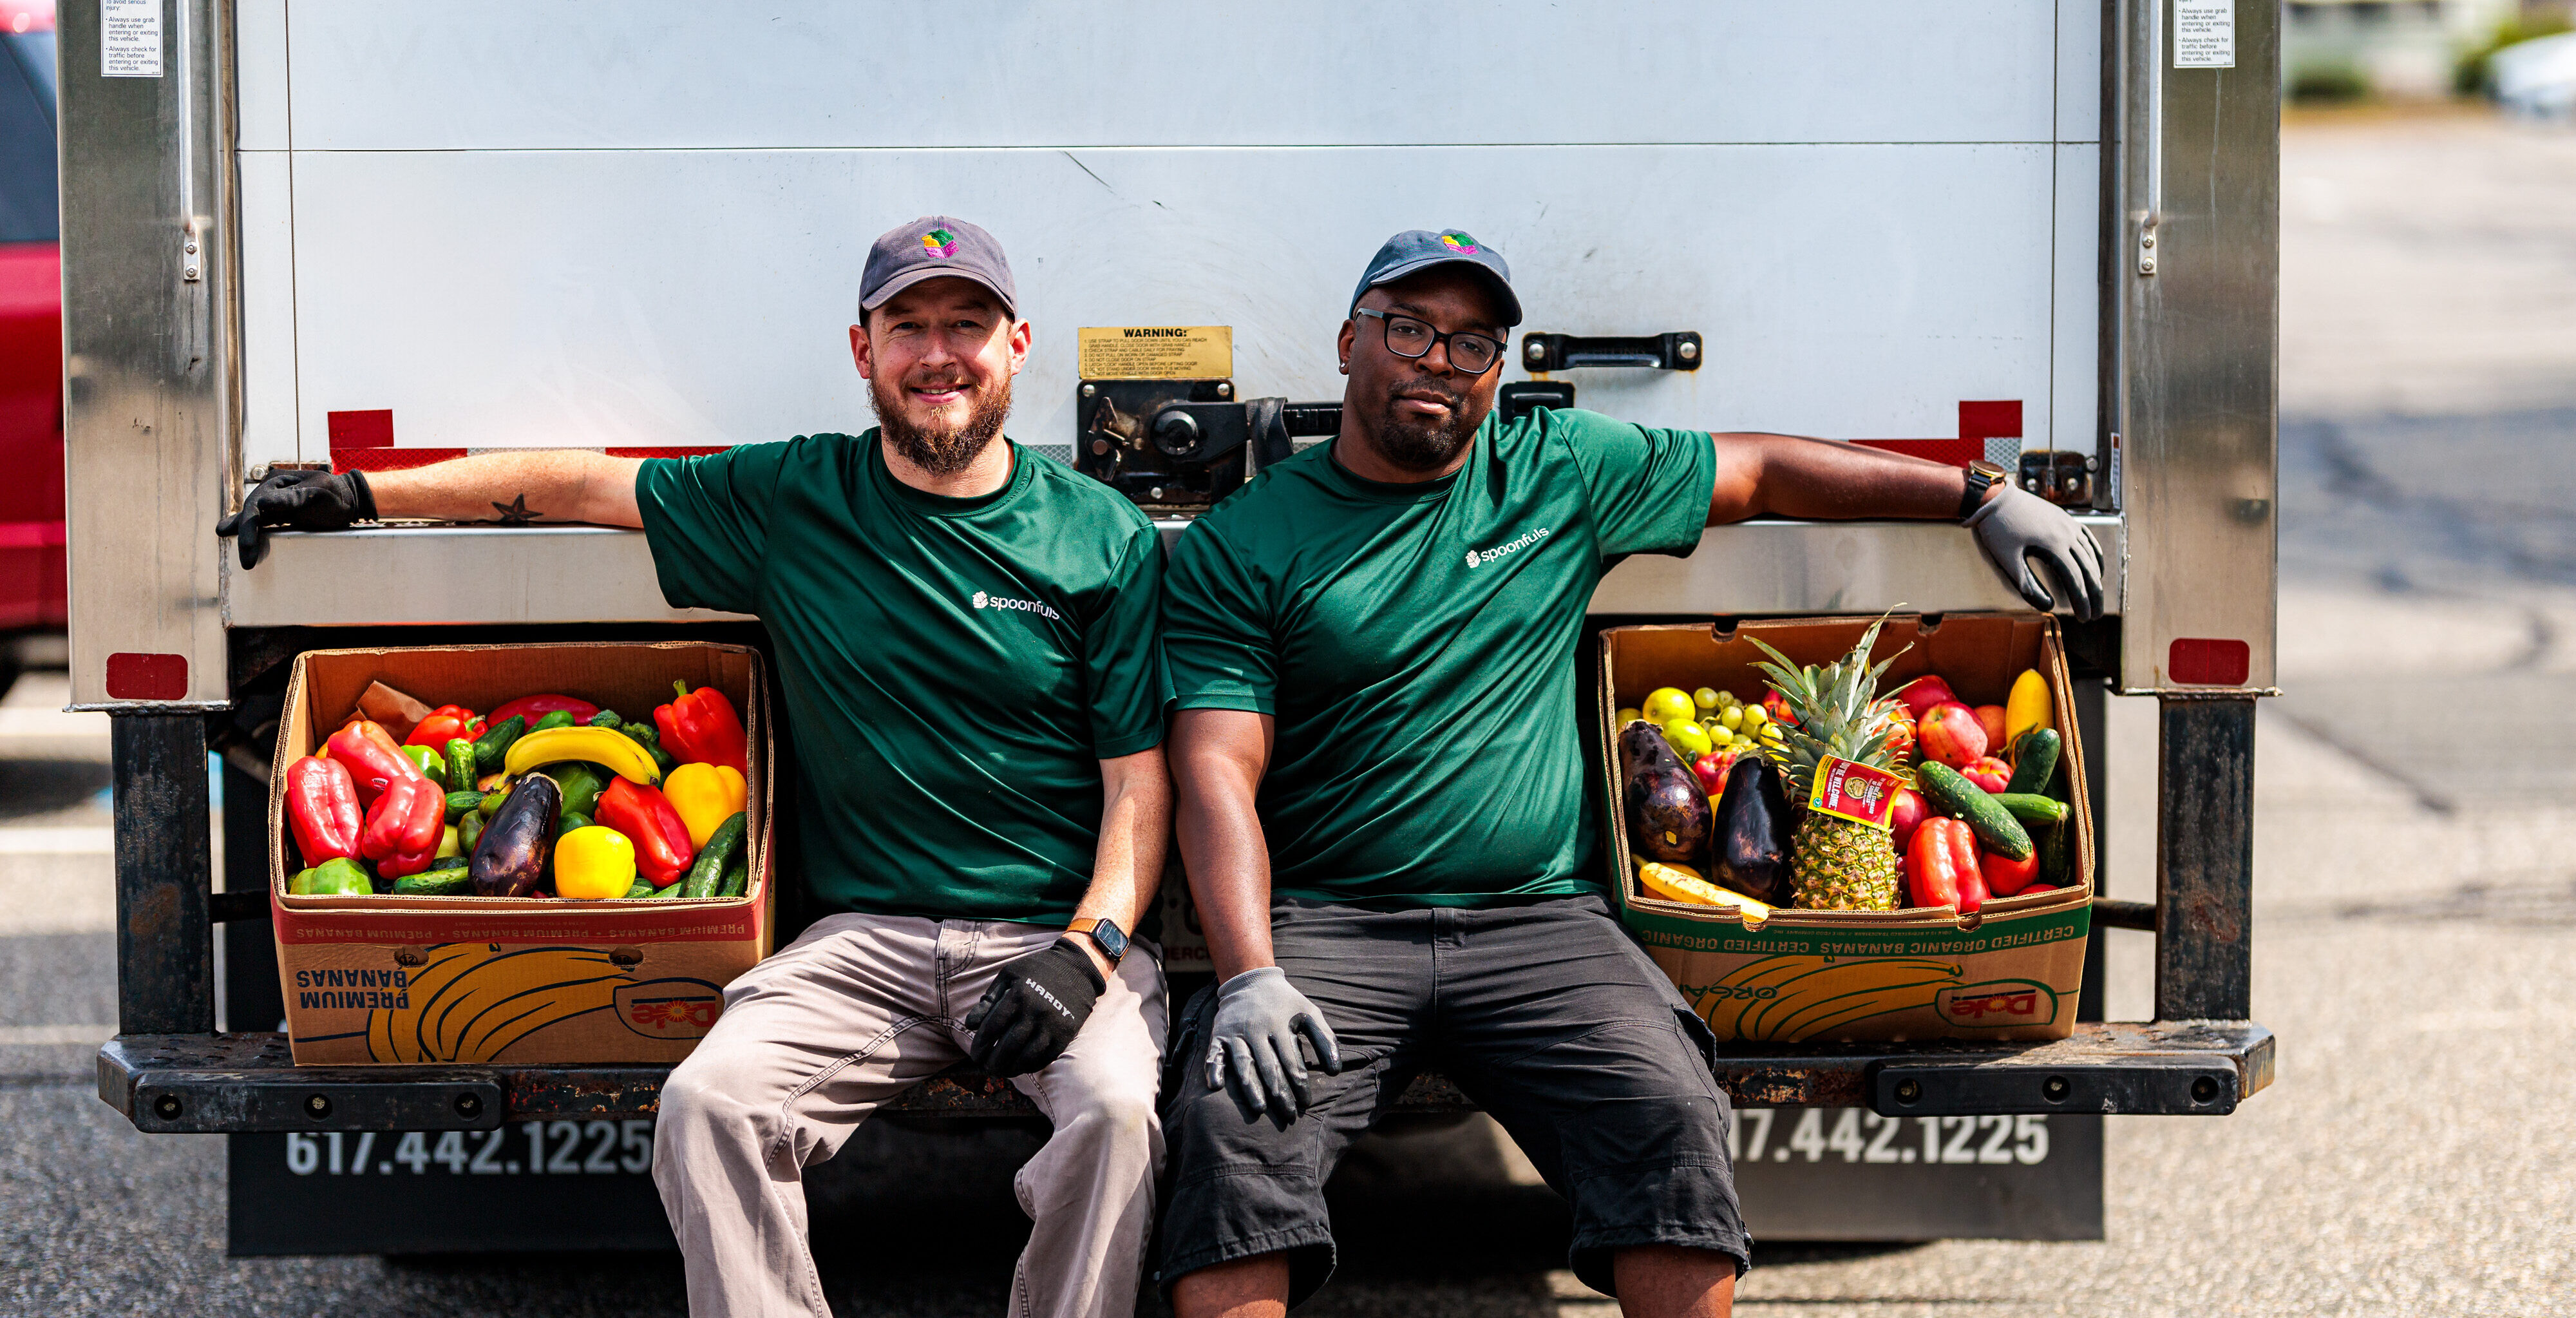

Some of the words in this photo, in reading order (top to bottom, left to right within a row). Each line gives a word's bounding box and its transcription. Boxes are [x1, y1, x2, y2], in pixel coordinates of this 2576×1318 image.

[1124, 328, 1187, 338] WARNING:
[1481, 528, 1549, 562] spoonfuls
[990, 597, 1060, 620] spoonfuls
[296, 928, 363, 938] BANANAS
[366, 930, 432, 939] PREMIUM
[452, 930, 520, 938] BANANAS
[523, 929, 589, 938] PREMIUM
[609, 927, 676, 937] BANANAS
[679, 924, 745, 935] PREMIUM
[1991, 925, 2075, 948] CERTIFIED
[1642, 930, 1718, 950] ORGANIC
[1723, 939, 1810, 953] CERTIFIED
[1910, 939, 1987, 953] ORGANIC
[1819, 942, 1905, 954] BANANAS
[295, 969, 407, 988] BANANAS
[1678, 984, 1777, 1000] ORGA
[299, 991, 410, 1009] PREMIUM
[1949, 994, 2037, 1019] Dole
[631, 1000, 716, 1029] Dole
[287, 1120, 652, 1175] 617.442.1225
